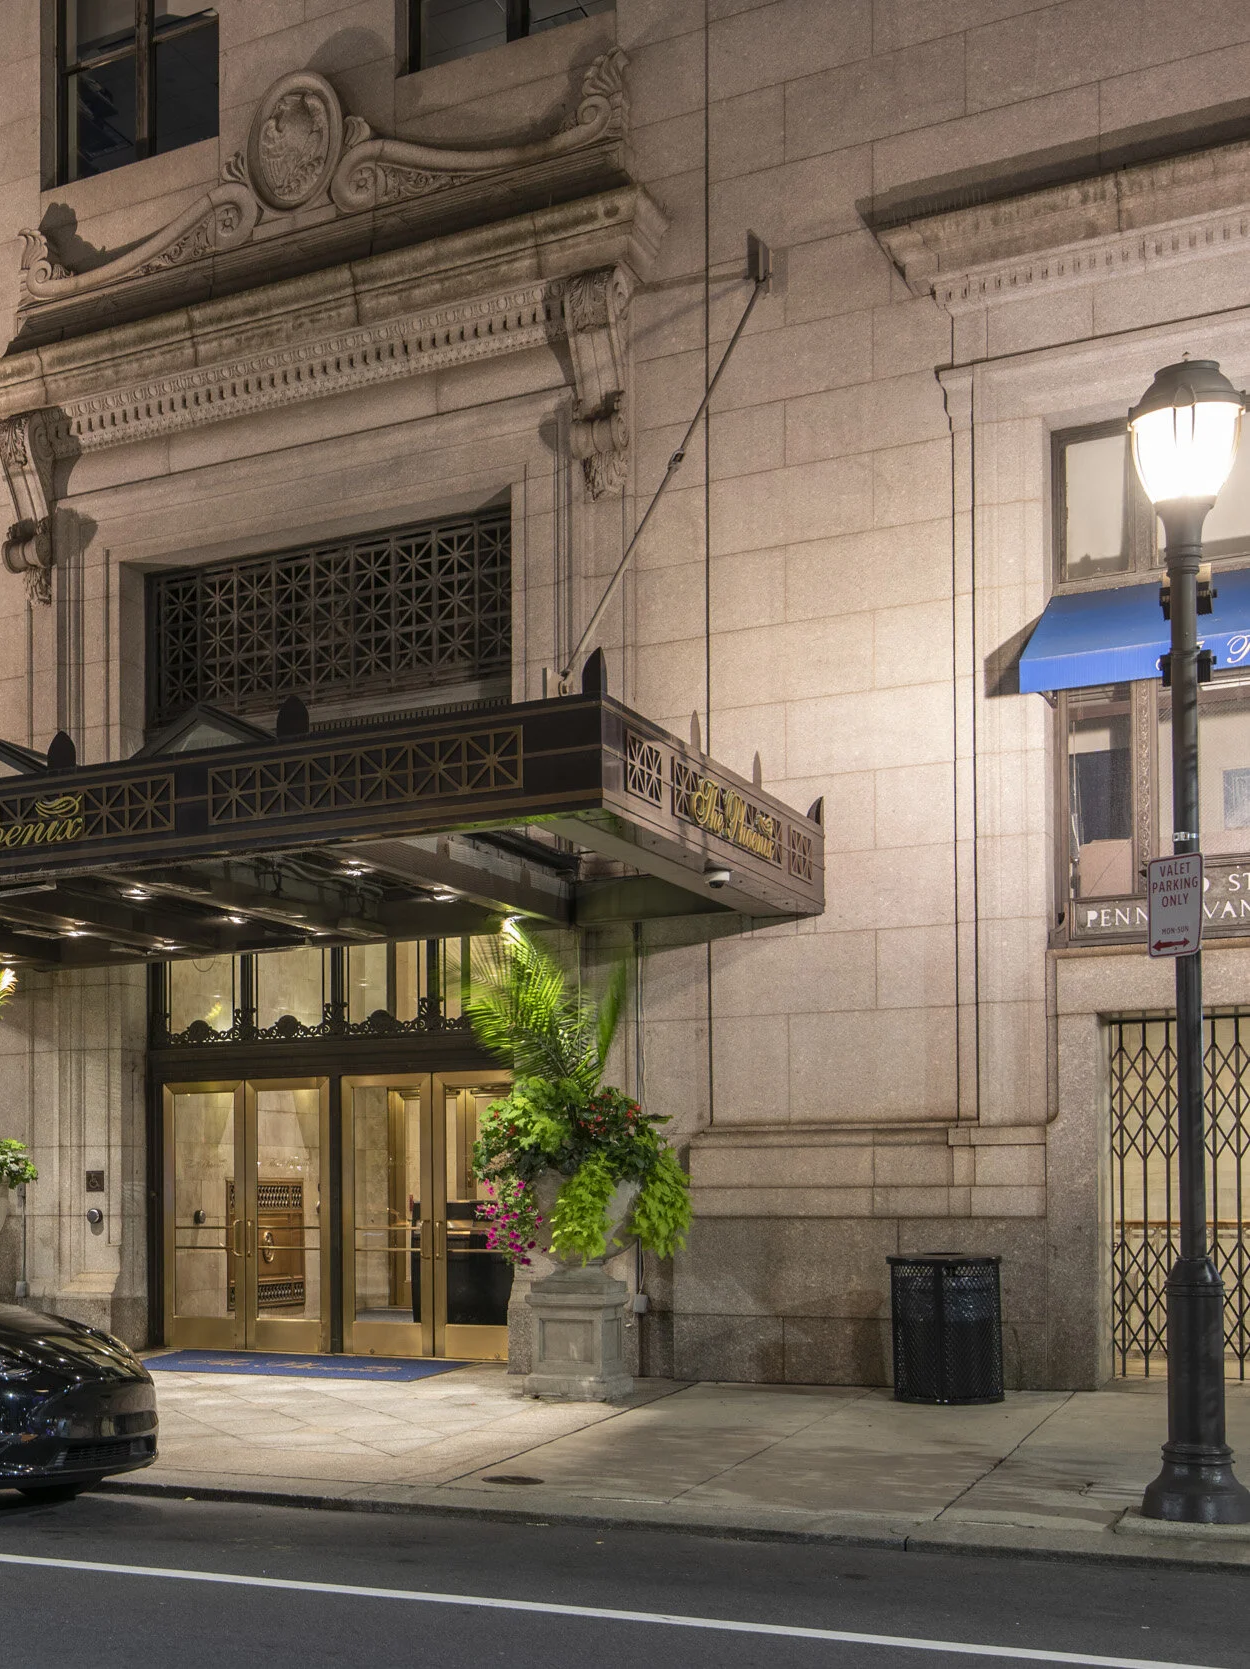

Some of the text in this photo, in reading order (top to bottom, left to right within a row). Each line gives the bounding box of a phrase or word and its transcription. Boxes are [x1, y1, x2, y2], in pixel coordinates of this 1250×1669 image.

[691, 778, 725, 833] The
[1160, 862, 1190, 878] VALET
[1152, 876, 1198, 894] PARKING
[1161, 893, 1190, 908] ONLY
[1161, 925, 1189, 936] MON-SUN
